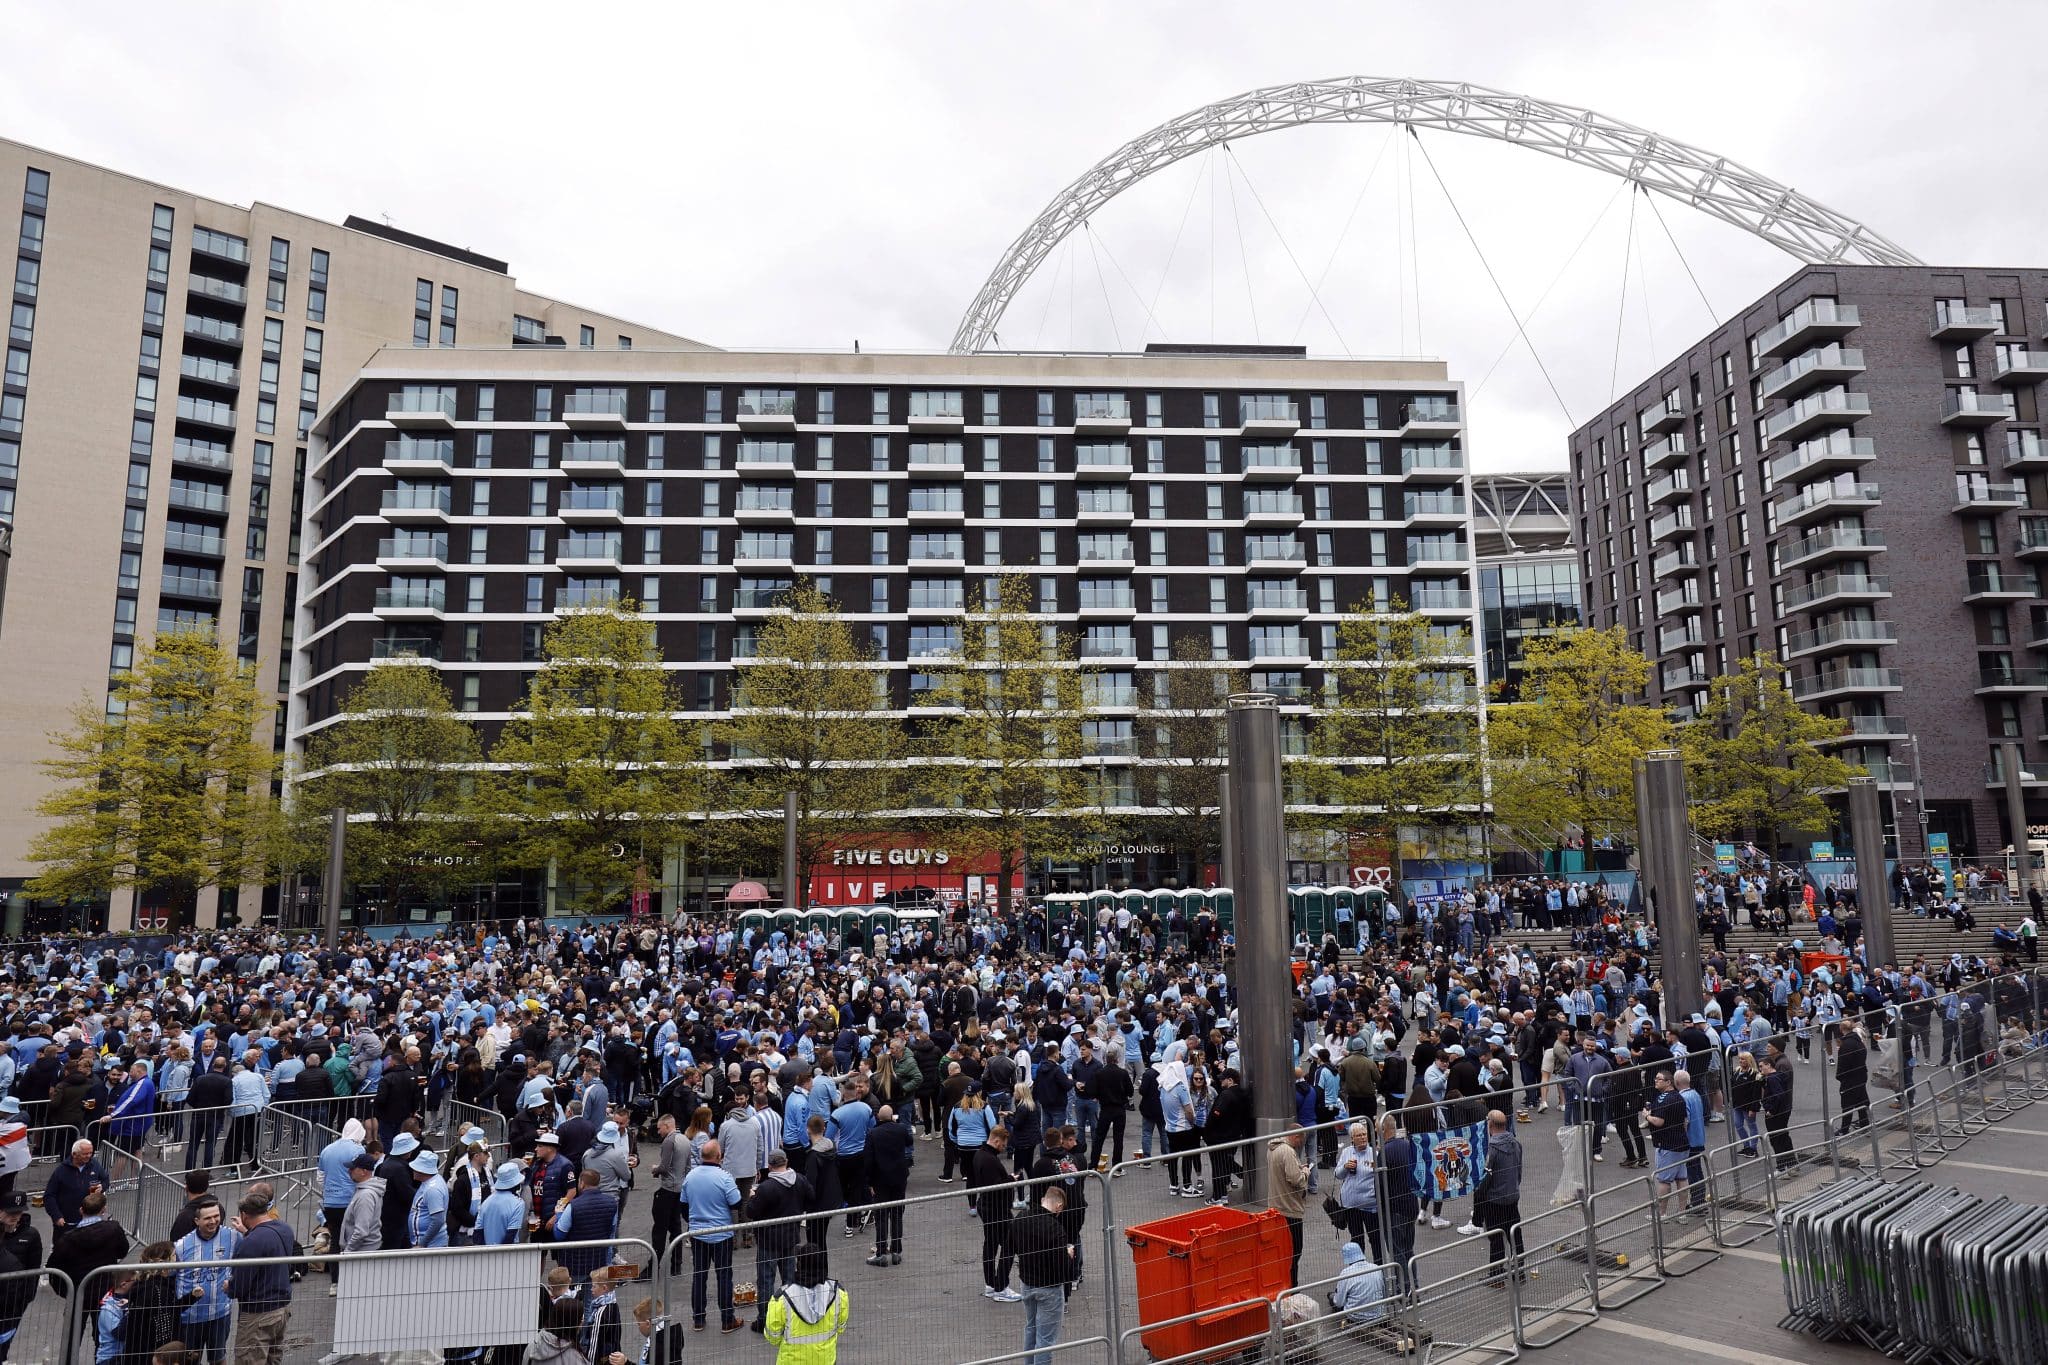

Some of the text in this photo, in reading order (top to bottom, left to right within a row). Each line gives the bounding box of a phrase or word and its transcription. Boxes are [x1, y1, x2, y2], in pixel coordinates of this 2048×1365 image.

[1122, 845, 1166, 854] LOUNGE
[833, 848, 949, 865] FIVE GUYS
[381, 857, 423, 866] WTE
